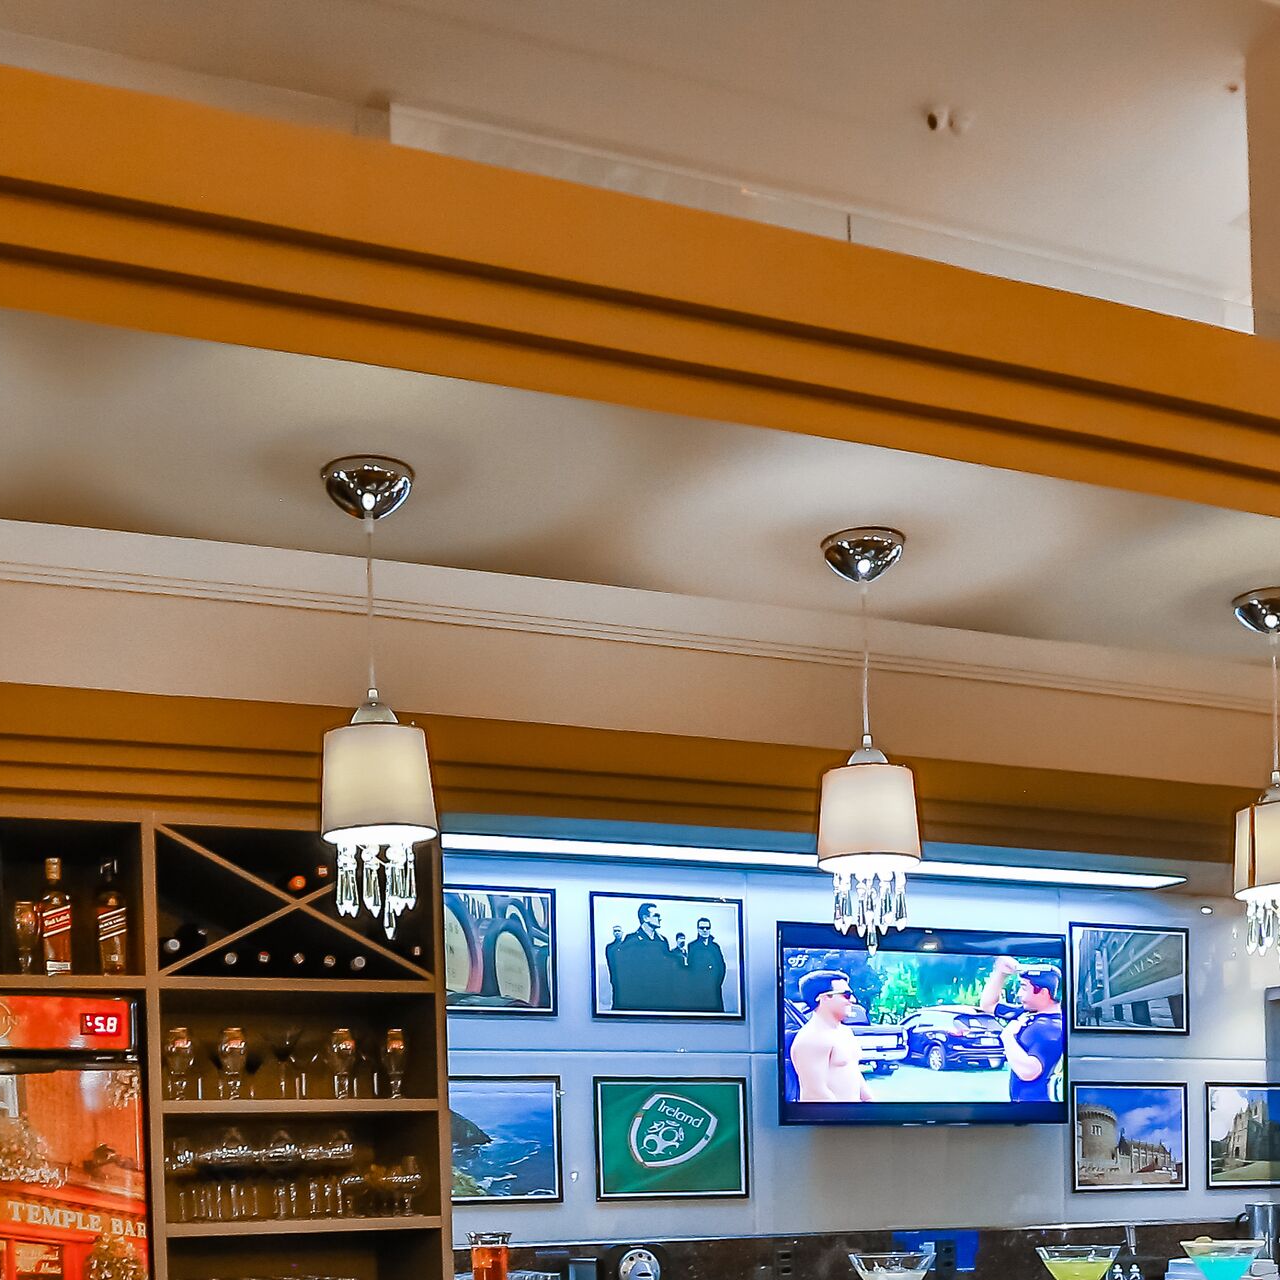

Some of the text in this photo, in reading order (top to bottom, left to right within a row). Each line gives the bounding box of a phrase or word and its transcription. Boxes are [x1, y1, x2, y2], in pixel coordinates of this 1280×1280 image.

[788, 955, 809, 967] off
[657, 1100, 705, 1128] Ireland
[7, 1200, 103, 1233] TEMPLE
[110, 1217, 147, 1239] BAR
